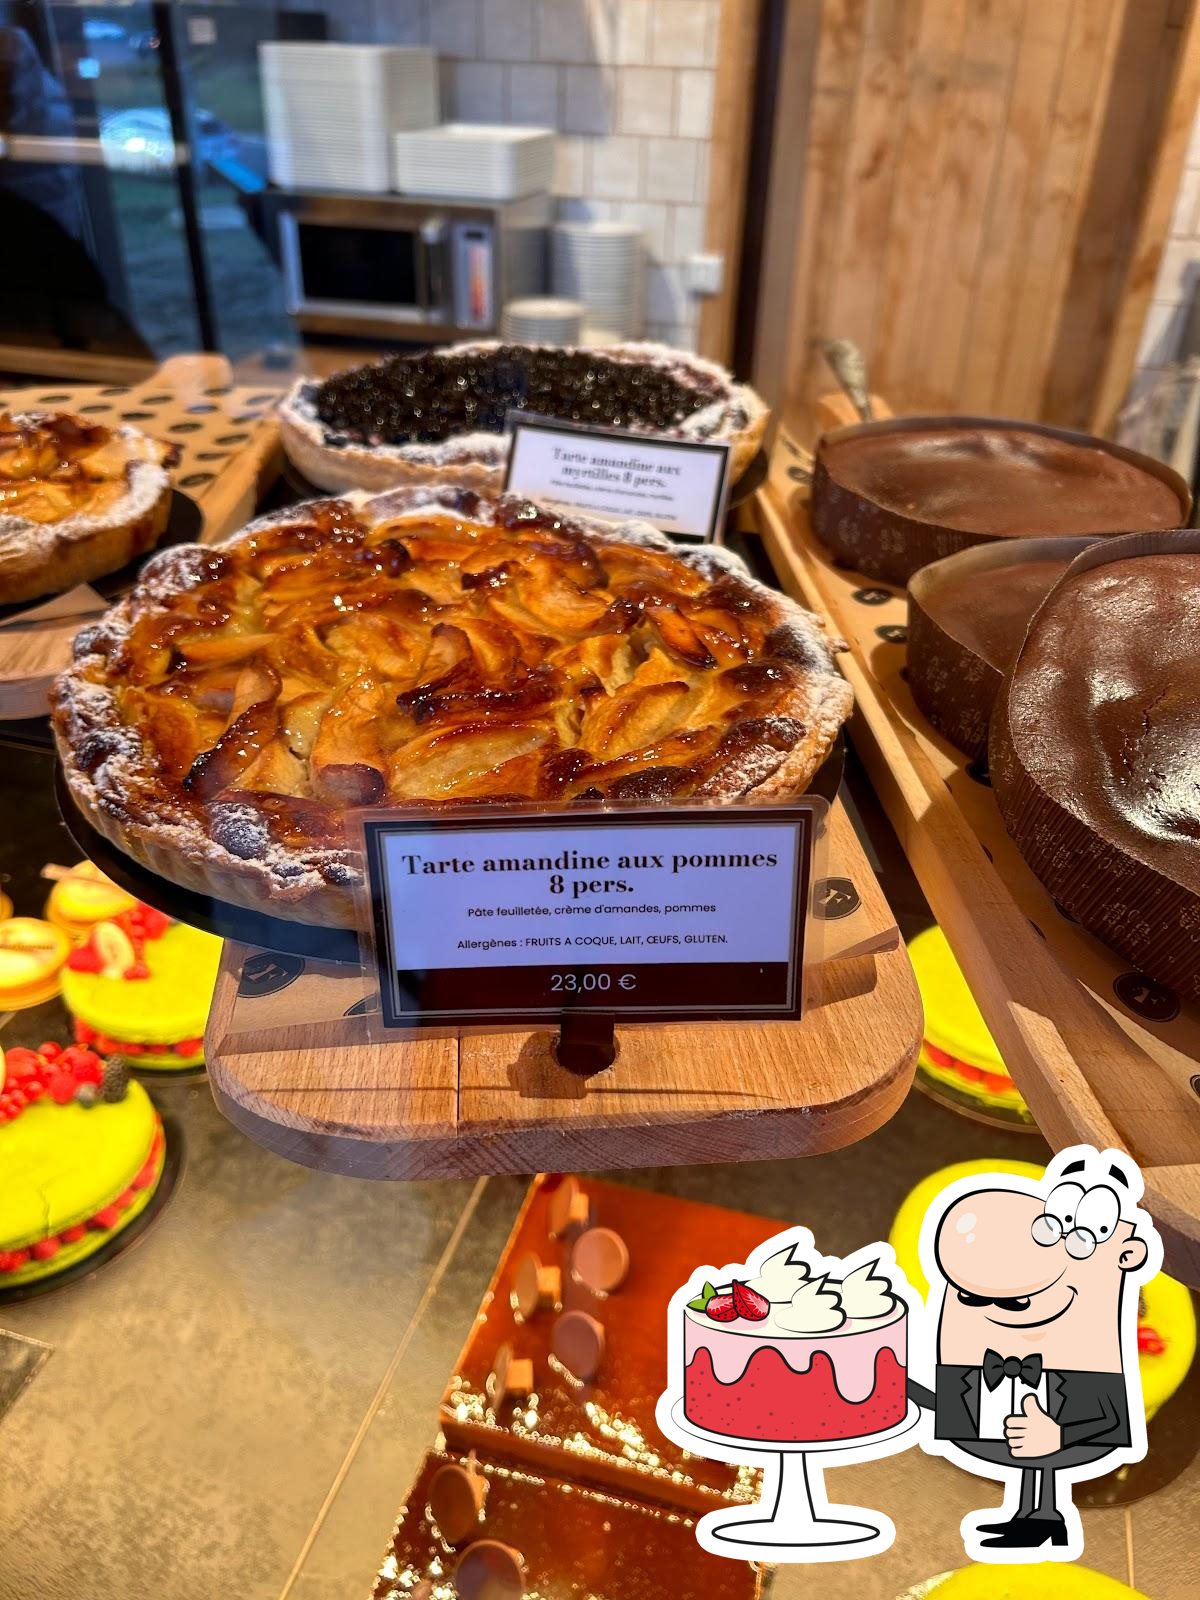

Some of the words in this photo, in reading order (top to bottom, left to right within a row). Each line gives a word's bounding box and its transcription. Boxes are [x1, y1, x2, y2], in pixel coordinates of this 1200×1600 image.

[553, 448, 587, 463] Tarte
[589, 457, 653, 471] amandine
[402, 855, 475, 875] Tarte
[482, 850, 610, 872] amandine
[617, 855, 664, 869] aux
[672, 853, 778, 873] pommes
[549, 874, 565, 894] 8
[572, 879, 634, 899] pers.
[468, 907, 494, 917] Pâte
[497, 906, 552, 916] feuilletée,
[554, 905, 592, 915] crème
[594, 904, 661, 914] d'amandes,
[664, 904, 717, 915] pommes
[457, 939, 517, 951] Allergènes
[525, 937, 561, 947] FRUITS
[564, 937, 572, 946] A
[574, 935, 617, 946] COQUE,
[620, 935, 644, 945] LAIT,
[646, 935, 681, 945] ŒUFS,
[684, 934, 728, 944] GLUTEN.
[551, 973, 611, 994] 23,00
[618, 973, 637, 990] €
